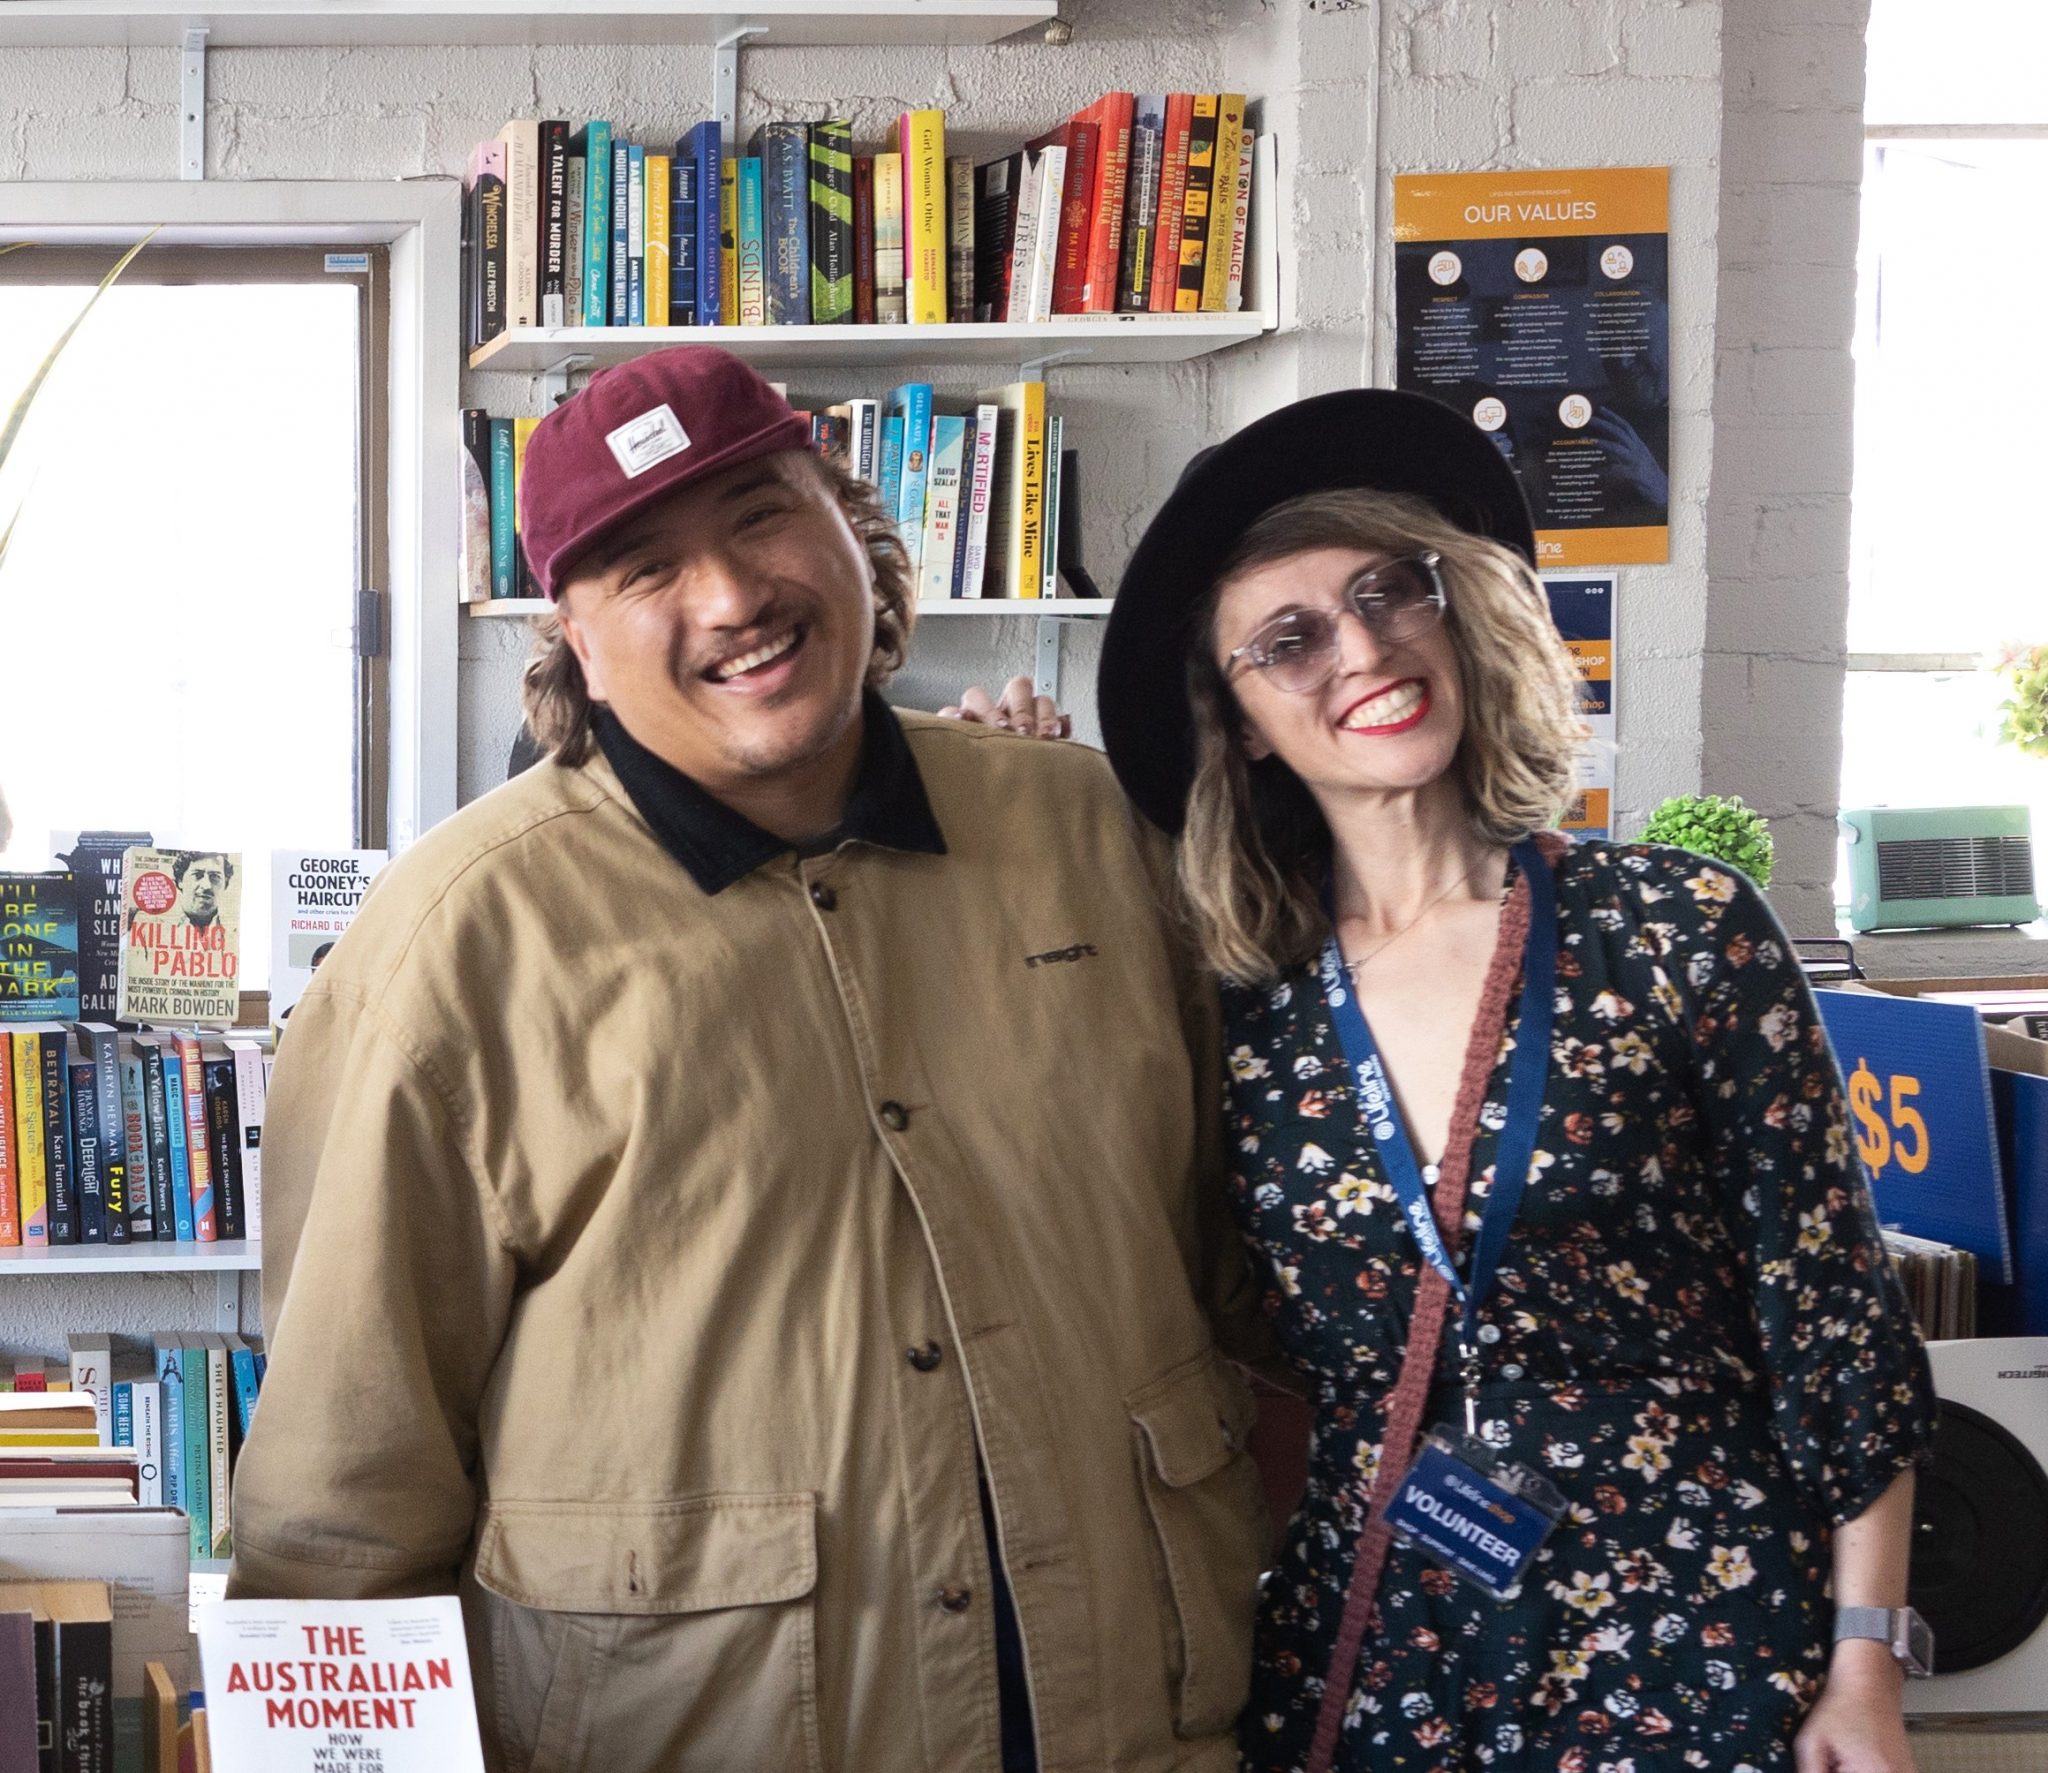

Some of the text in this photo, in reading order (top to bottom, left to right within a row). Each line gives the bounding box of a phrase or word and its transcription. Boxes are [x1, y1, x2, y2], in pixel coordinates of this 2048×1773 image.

[551, 155, 564, 195] TALENT
[708, 149, 716, 200] FAITHFUL
[782, 142, 794, 210] A.S. BYATT
[923, 129, 932, 234] Girl, Woman, Other
[1073, 133, 1086, 197] BEIJING COMA
[551, 200, 561, 218] FOR
[616, 150, 626, 229] MOUTH TO MOUTH
[1100, 152, 1116, 225] BARRY DIVOLA
[1109, 128, 1128, 249] DRIVING STEVIE FRACASSO
[1161, 153, 1175, 226] BARRY DIVOLA
[1168, 131, 1187, 251] DRIVING STEVIE FRACASSO
[1230, 158, 1249, 282] A TON OF MALICE
[1464, 202, 1597, 223] OUR VALUES
[549, 223, 561, 273] MURDER
[708, 212, 716, 299] ALICE HOFFMAN
[778, 238, 788, 274] BOOK
[789, 217, 800, 299] The Children's
[1014, 212, 1031, 269] FIRES
[1067, 232, 1078, 269] MA JIAN
[487, 261, 497, 312] ALEX PRESTON
[615, 241, 626, 317] ANTOINE WILSON
[742, 239, 760, 317] BLINDS
[827, 230, 838, 310] Alan Hollinghurst
[913, 393, 924, 443] GILL PAUL
[861, 413, 872, 470] THE MIDNIGHT
[934, 477, 958, 487] SZALAY
[937, 467, 956, 476] DAVID
[935, 511, 951, 519] THAT
[938, 499, 949, 508] ALL
[1024, 439, 1040, 558] Lives Like Mine
[935, 521, 949, 530] MAN
[938, 532, 945, 541] IS
[964, 545, 974, 593] NADELBERG
[973, 545, 981, 570] DAVID
[1575, 656, 1605, 666] SHOP
[101, 859, 121, 874] WH
[105, 879, 122, 895] WE
[289, 874, 370, 890] CLOONEY'S
[300, 858, 359, 873] GEORGE
[298, 891, 362, 906] HAIRCUT
[131, 922, 225, 951] KILLING
[291, 920, 329, 930] RICHARD
[0, 962, 47, 976] THE
[8, 943, 33, 957] IN
[154, 951, 237, 979] PABLO
[138, 977, 153, 985] INSIDE
[155, 978, 170, 986] STORY
[142, 987, 167, 995] POWERFUL
[169, 988, 192, 996] CRIMINAL
[127, 996, 233, 1016] MARK BOWDEN
[23, 1058, 37, 1109] Chicken
[149, 1054, 160, 1076] The
[46, 1049, 59, 1128] BETRAYAL
[85, 1090, 94, 1128] FRANCES
[103, 1043, 119, 1157] KATHRYN HEYMAN
[151, 1078, 162, 1116] Yellow
[26, 1111, 38, 1154] Sisters
[77, 1090, 88, 1134] HARDINGE
[1848, 1056, 1930, 1180] $5
[53, 1135, 67, 1212] Kate Furnivall
[80, 1138, 100, 1196] DEEPLIGHT
[126, 1113, 146, 1203] BOOK DAYS
[108, 1166, 124, 1214] Fury
[156, 1158, 167, 1211] Kevin Powers
[215, 1363, 223, 1383] SHE
[216, 1388, 222, 1398] IS
[118, 1393, 129, 1437] SOME HERE
[167, 1398, 179, 1472] PARIS Affair
[216, 1402, 224, 1454] HAUNTED
[194, 1444, 203, 1513] PETINA GAPPAH
[1405, 1485, 1521, 1568] VOLUNTEER
[301, 1625, 367, 1656] THE
[227, 1658, 454, 1693] AUSTRALIAN
[265, 1698, 417, 1729] MOMENT
[313, 1748, 384, 1760] WE WERE
[328, 1733, 363, 1746] HOW
[314, 1762, 384, 1773] MADE FOR
